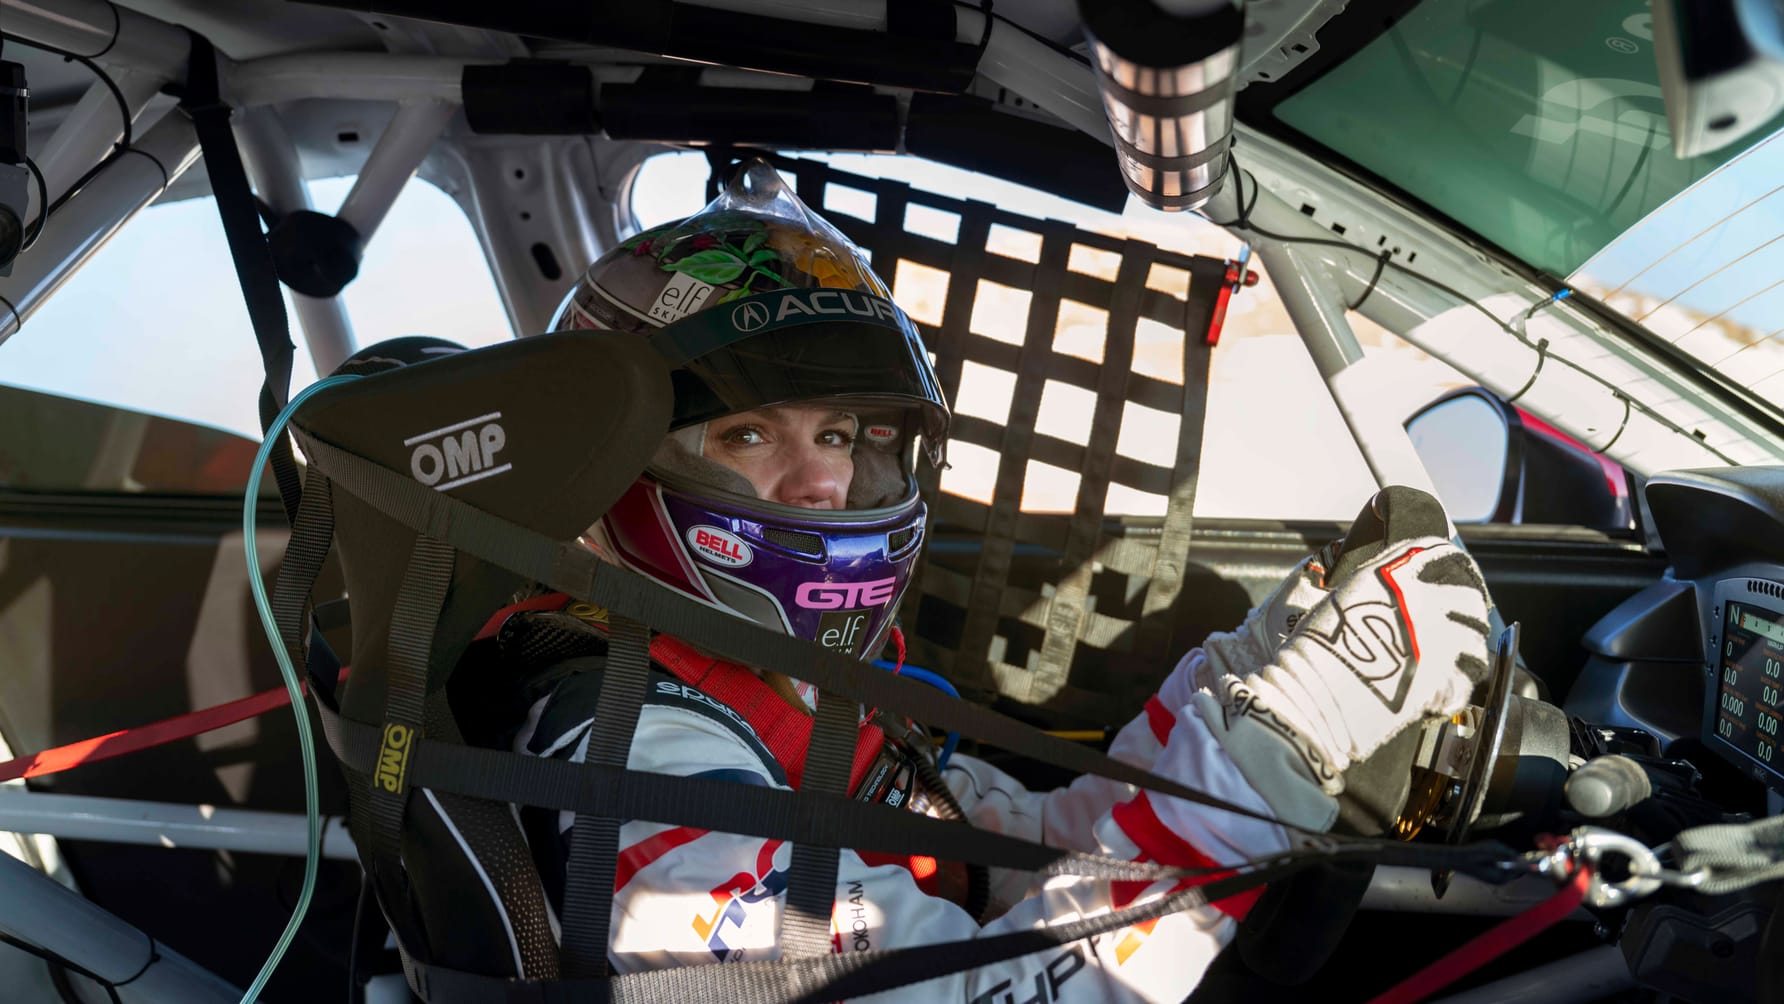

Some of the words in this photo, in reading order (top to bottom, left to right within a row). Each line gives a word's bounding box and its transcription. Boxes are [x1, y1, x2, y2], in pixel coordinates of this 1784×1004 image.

[652, 308, 676, 322] SKI
[776, 291, 899, 322] ACUR
[411, 423, 506, 487] OMP
[696, 529, 743, 560] BELL
[699, 545, 736, 563] HELMETS
[1730, 605, 1740, 625] N
[1726, 641, 1733, 656] 0
[1724, 667, 1737, 685] 0.0
[1766, 658, 1780, 678] 0.0
[1722, 693, 1743, 717] 0.000
[1763, 686, 1777, 706] 0.0
[1720, 718, 1732, 738] 0.0
[1758, 712, 1777, 735] 0.00
[380, 725, 407, 792] OMP
[1758, 741, 1772, 762] 0.0
[888, 789, 902, 806] OMP
[847, 880, 869, 953] OKOHAM
